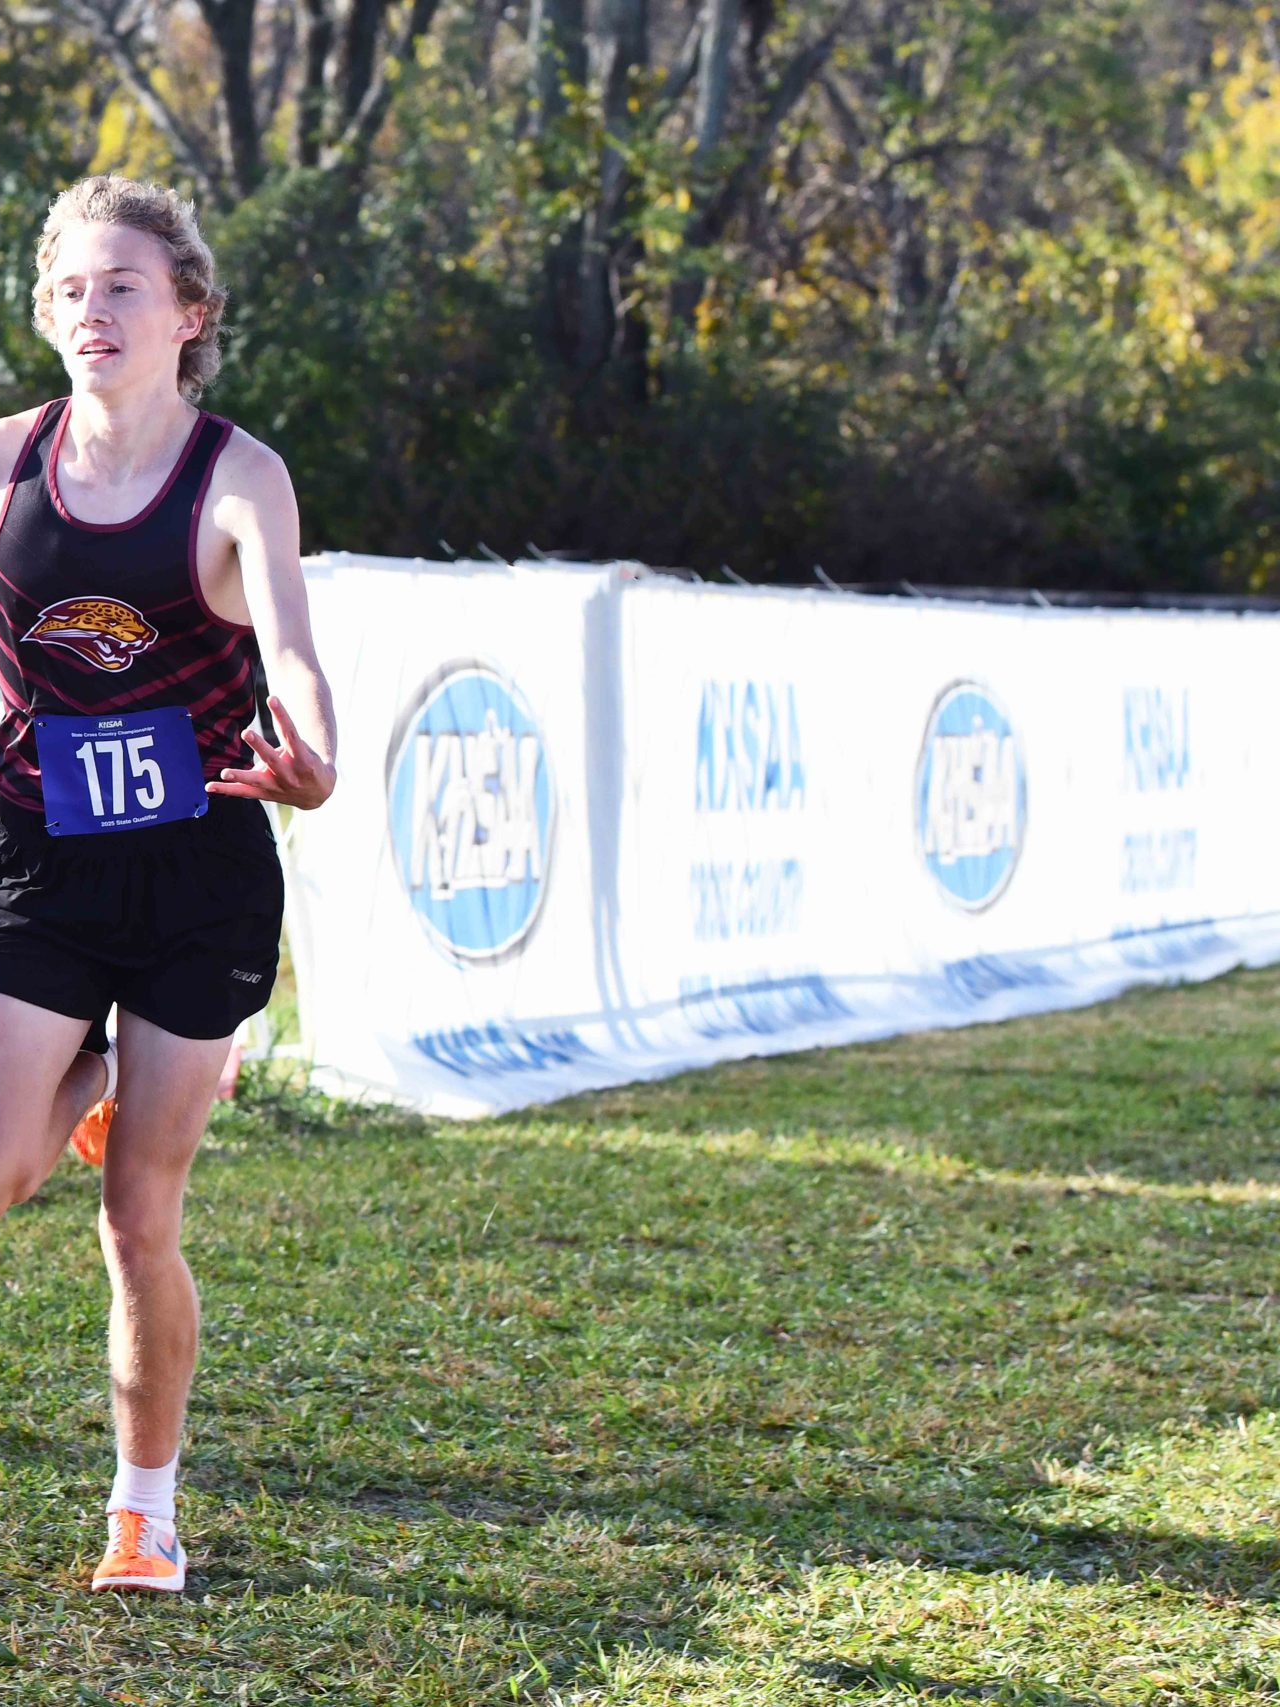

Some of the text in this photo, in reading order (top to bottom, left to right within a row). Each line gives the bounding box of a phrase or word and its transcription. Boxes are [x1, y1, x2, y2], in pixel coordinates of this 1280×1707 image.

[98, 720, 123, 729] KHSAA
[117, 726, 155, 736] Championships
[76, 735, 165, 817] 175
[132, 814, 158, 823] Qualifier
